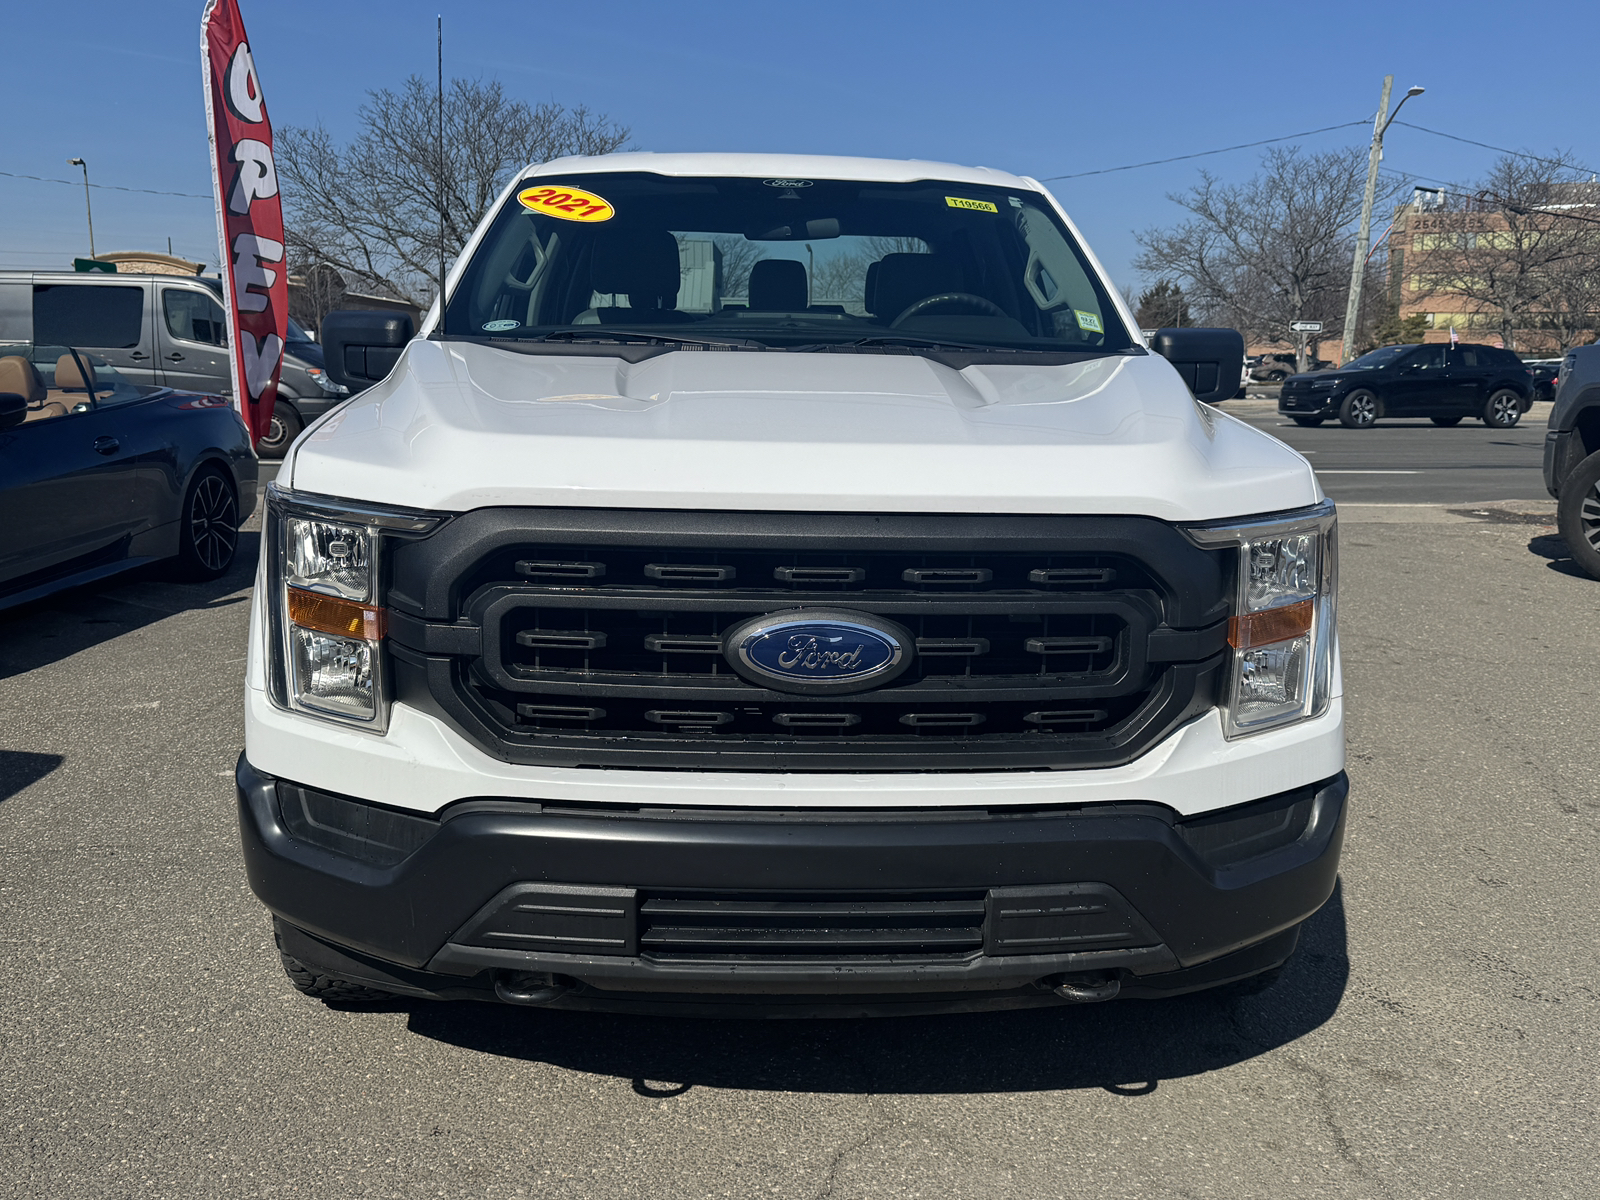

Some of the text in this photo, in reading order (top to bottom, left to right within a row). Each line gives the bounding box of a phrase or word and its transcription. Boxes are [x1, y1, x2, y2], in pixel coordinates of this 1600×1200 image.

[771, 179, 804, 187] Ford
[523, 189, 607, 217] 2021
[951, 199, 992, 211] T19566
[778, 634, 864, 669] Ford
